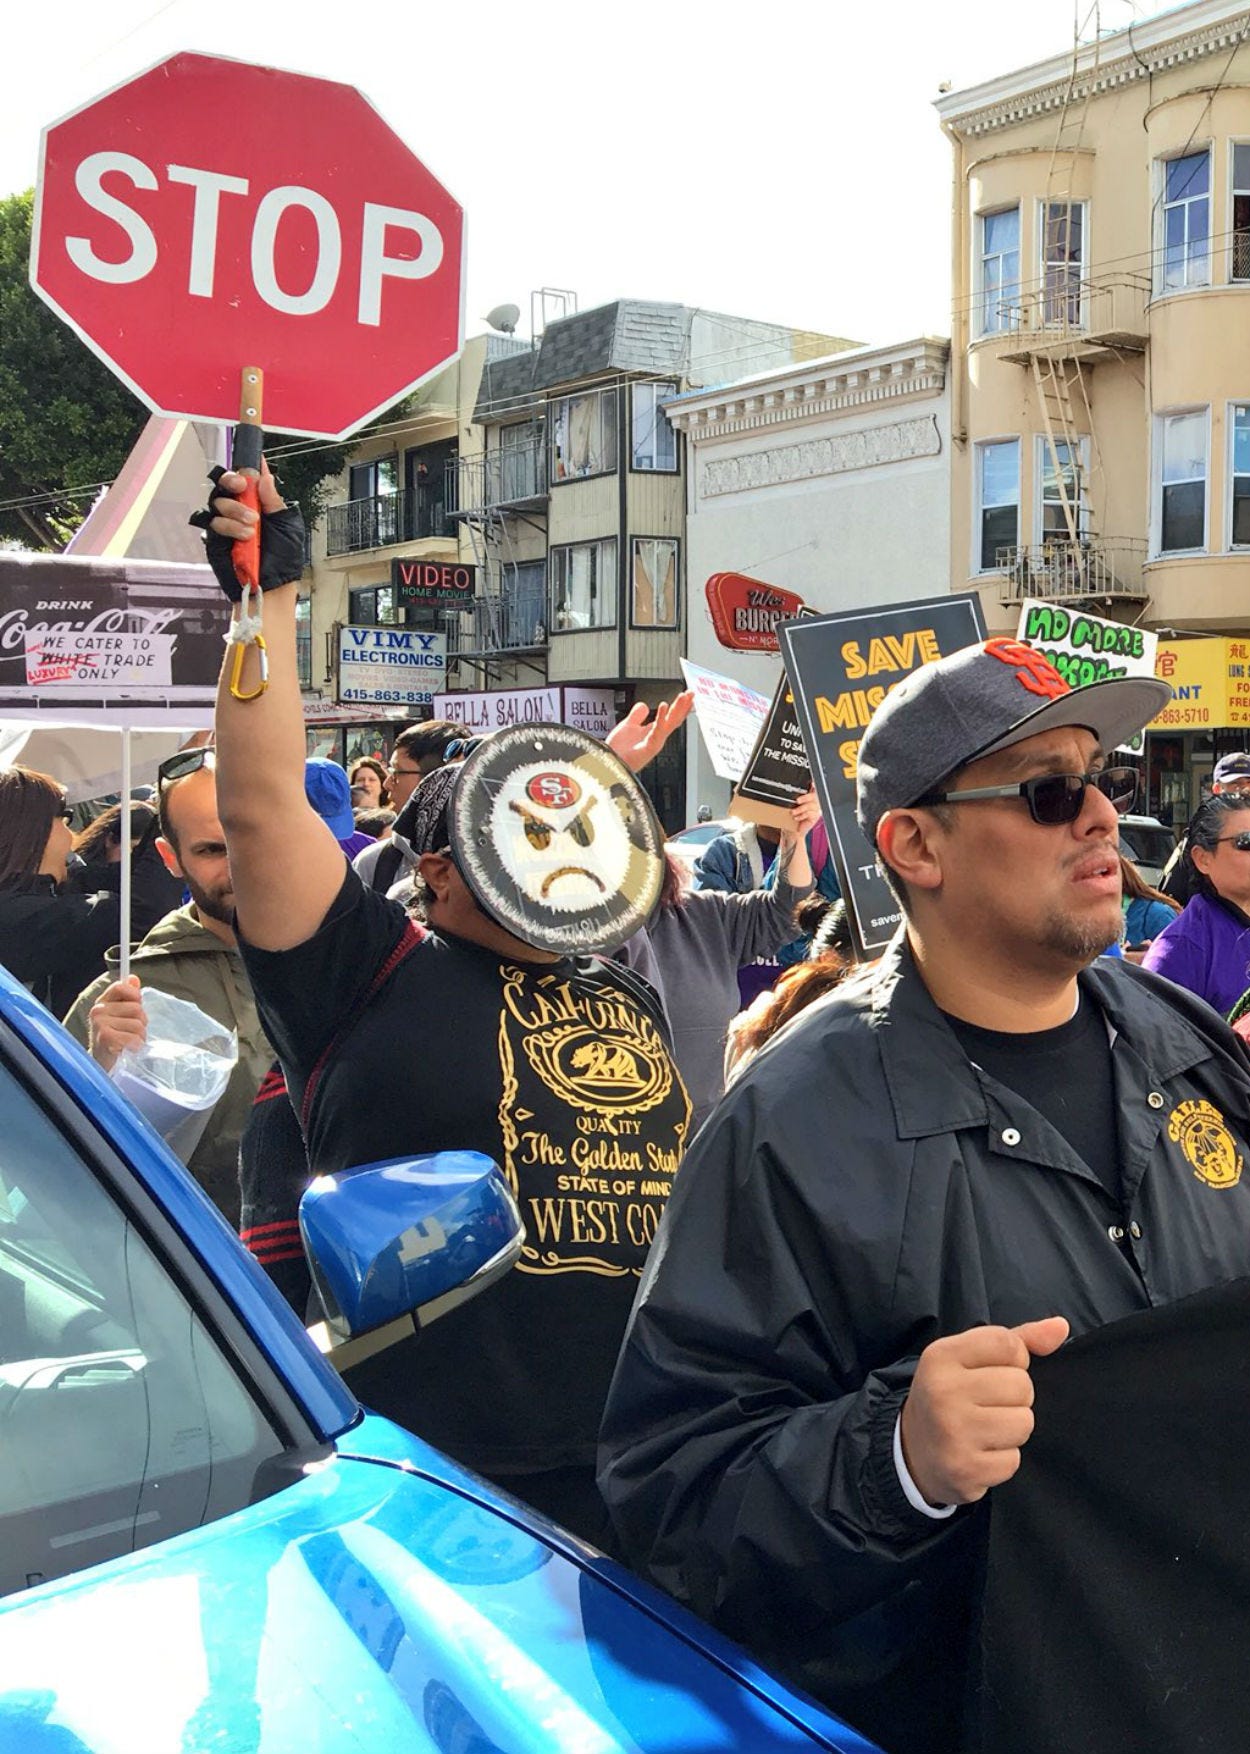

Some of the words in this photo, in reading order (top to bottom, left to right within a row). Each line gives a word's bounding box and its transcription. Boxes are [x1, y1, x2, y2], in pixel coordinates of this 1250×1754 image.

[65, 151, 443, 327] STOP
[400, 563, 470, 589] VIDEO
[402, 586, 433, 598] HOME
[35, 600, 94, 610] DRINK
[735, 606, 797, 633] BURG
[44, 636, 65, 649] WE
[75, 637, 122, 650] CATER
[133, 638, 150, 650] TO
[348, 629, 438, 650] VIMY
[1024, 606, 1071, 642] NO
[1071, 616, 1145, 659] MORE
[41, 653, 93, 666] WHITE
[104, 654, 156, 667] TRADE
[342, 649, 444, 667] ELECTRONICS
[841, 628, 942, 679] SAVE
[28, 666, 70, 681] LUXURY
[78, 668, 119, 680] ONLY
[343, 688, 433, 703] 415-863-838
[444, 700, 490, 728] BELLA
[496, 696, 543, 724] SALON
[571, 701, 607, 716] BELLA
[780, 738, 791, 749] TO
[764, 747, 781, 760] THE
[781, 751, 811, 769] MISSIO
[520, 1131, 567, 1166] The
[571, 1137, 643, 1176] Golden
[648, 1142, 679, 1174] Stat
[556, 1175, 609, 1195] STATE
[612, 1180, 635, 1196] OF
[640, 1181, 672, 1197] MIND
[527, 1198, 622, 1245] WEST
